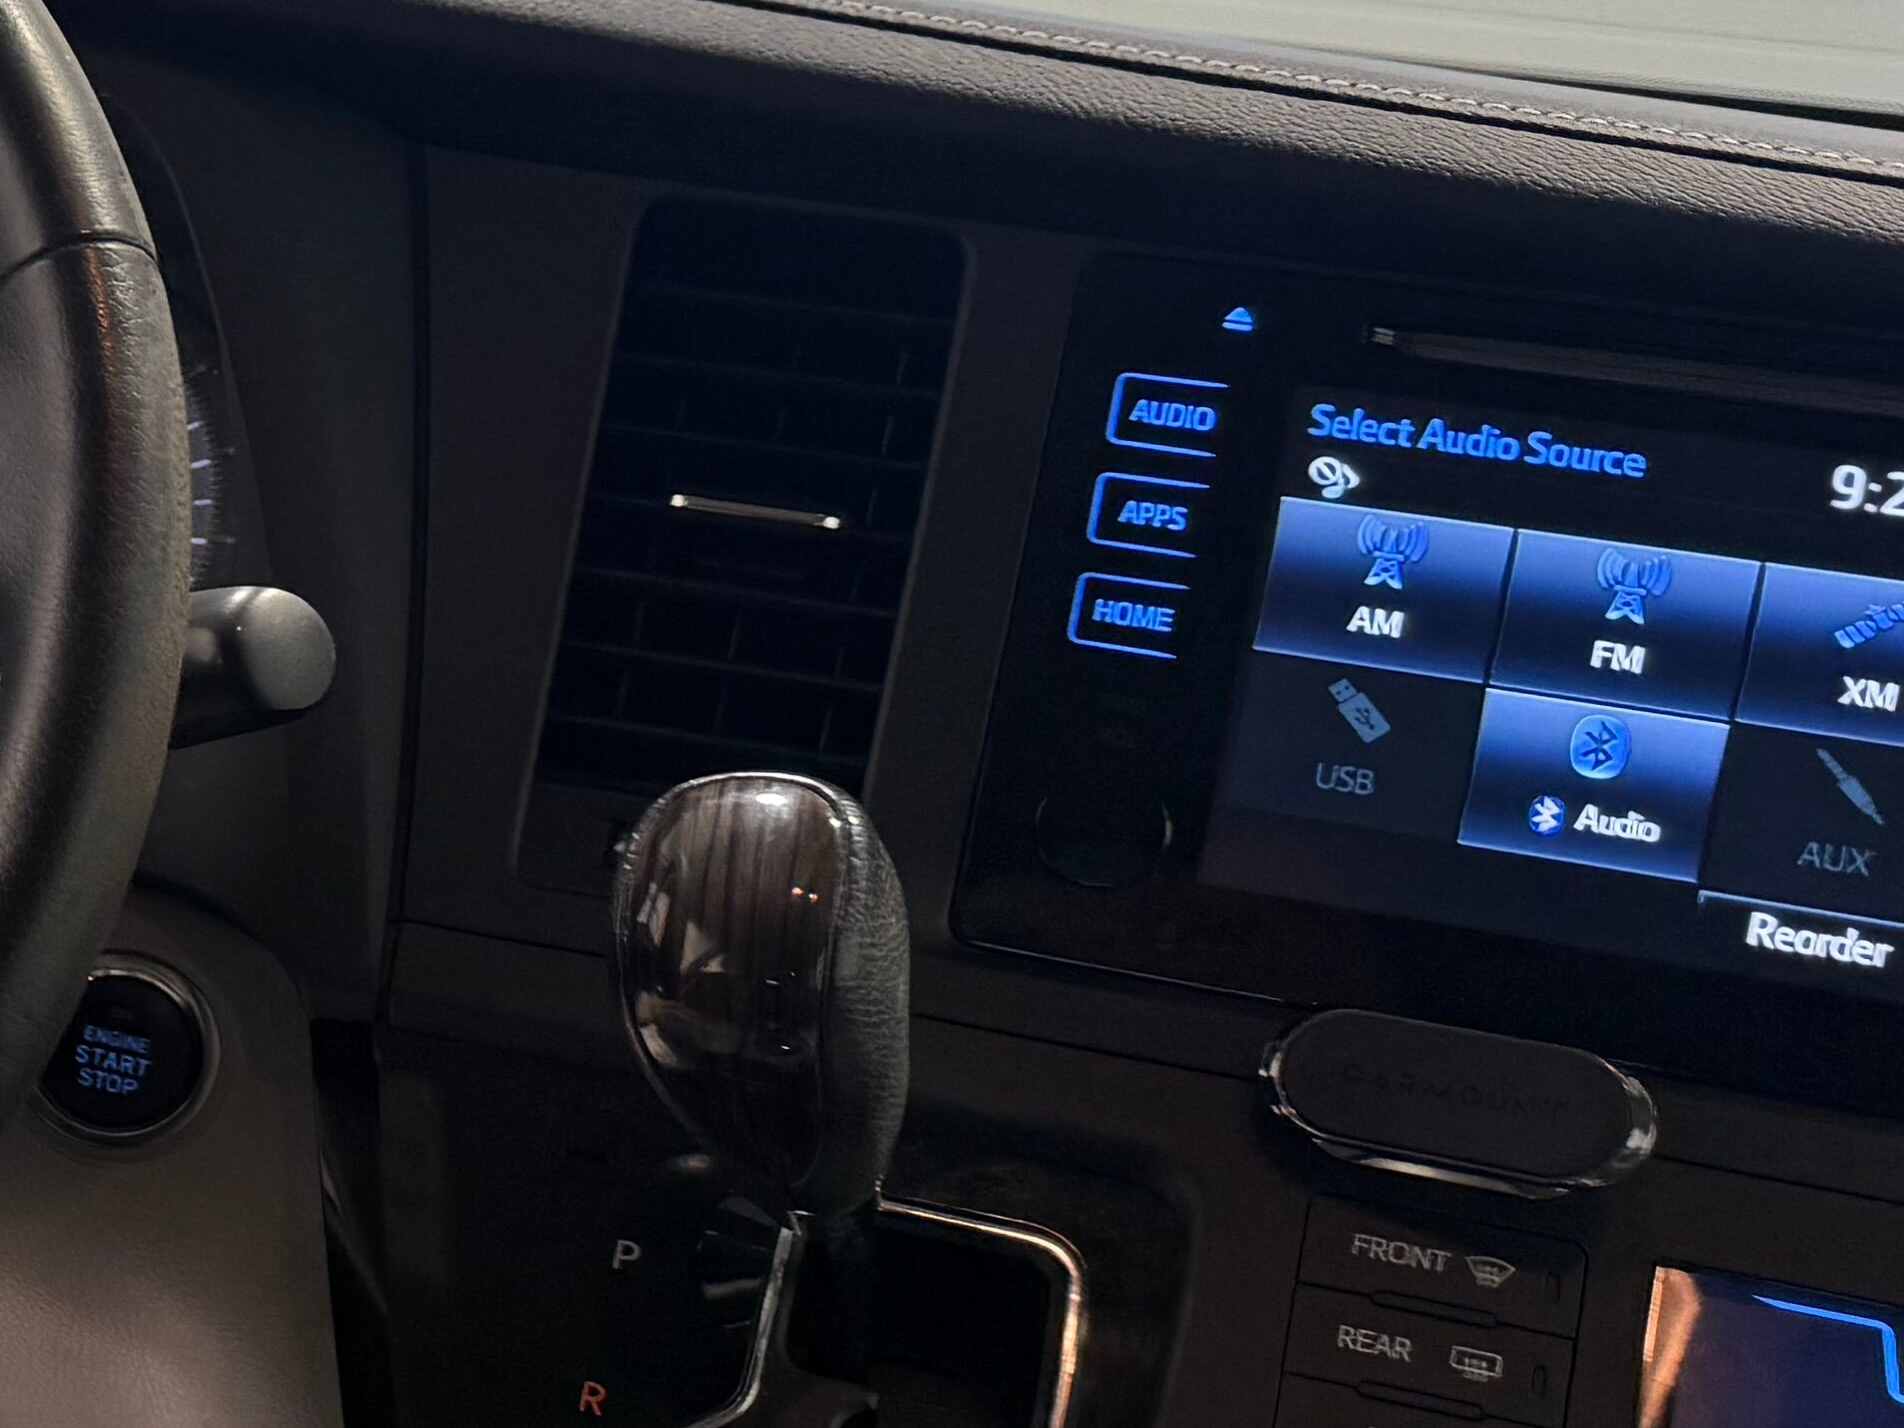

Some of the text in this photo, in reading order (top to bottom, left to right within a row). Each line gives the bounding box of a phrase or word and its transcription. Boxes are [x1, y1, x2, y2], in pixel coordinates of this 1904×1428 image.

[1129, 399, 1216, 431] AUDIO
[1307, 403, 1648, 479] Select Audio Source
[1117, 500, 1188, 532] APPS
[1093, 598, 1175, 633] HOME
[1347, 606, 1404, 639] AM
[1591, 641, 1646, 676] FM
[1838, 676, 1899, 713] XM
[1315, 762, 1375, 797] USB
[1573, 803, 1661, 845] Audio
[1797, 840, 1876, 878] AUX
[1745, 911, 1895, 970] Reorder
[82, 1025, 151, 1054] ENGINE
[74, 1044, 152, 1076] START
[77, 1068, 139, 1095] STOP
[611, 1239, 643, 1270] P
[1351, 1232, 1452, 1274] FRONT
[1336, 1324, 1413, 1364] REAR
[578, 1380, 607, 1416] R
